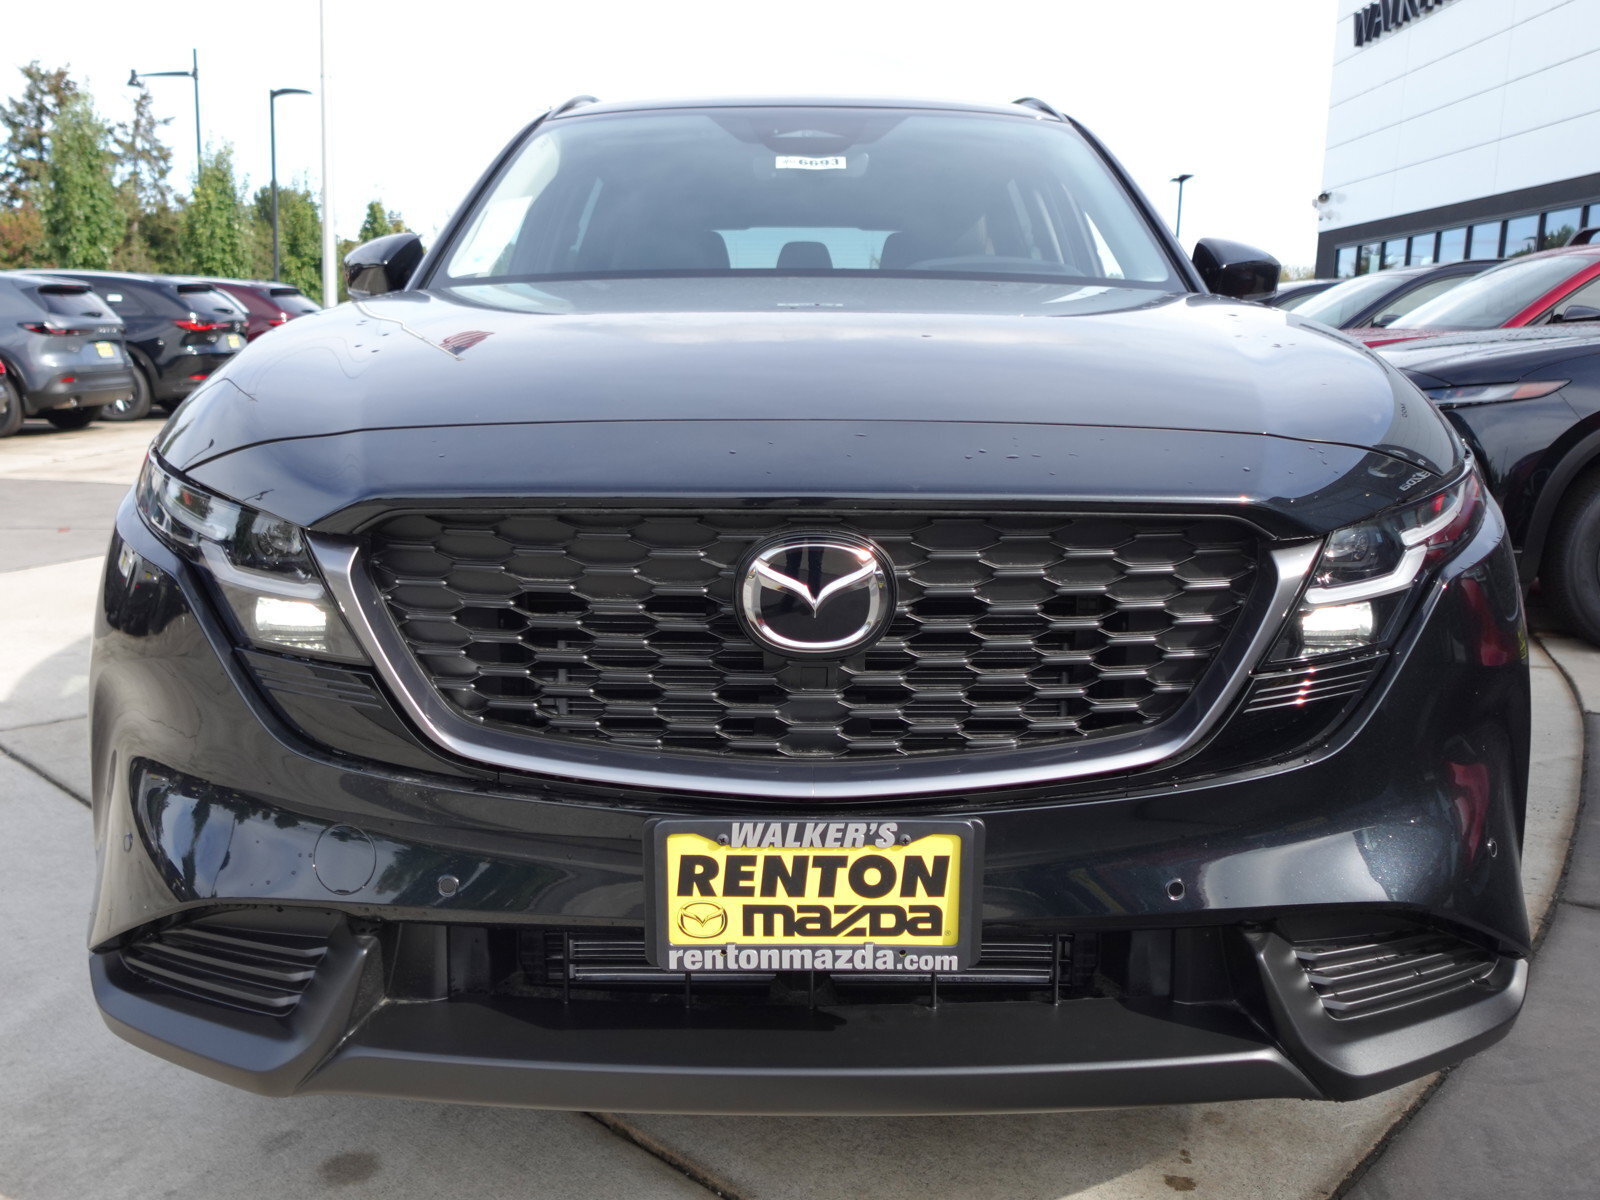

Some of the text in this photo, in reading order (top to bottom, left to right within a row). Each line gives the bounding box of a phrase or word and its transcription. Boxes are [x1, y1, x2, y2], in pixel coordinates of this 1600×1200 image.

[730, 822, 898, 848] WALKER'S
[676, 854, 951, 899] RENTON
[742, 904, 944, 937] mazda
[668, 942, 959, 971] rentonmazda.com
